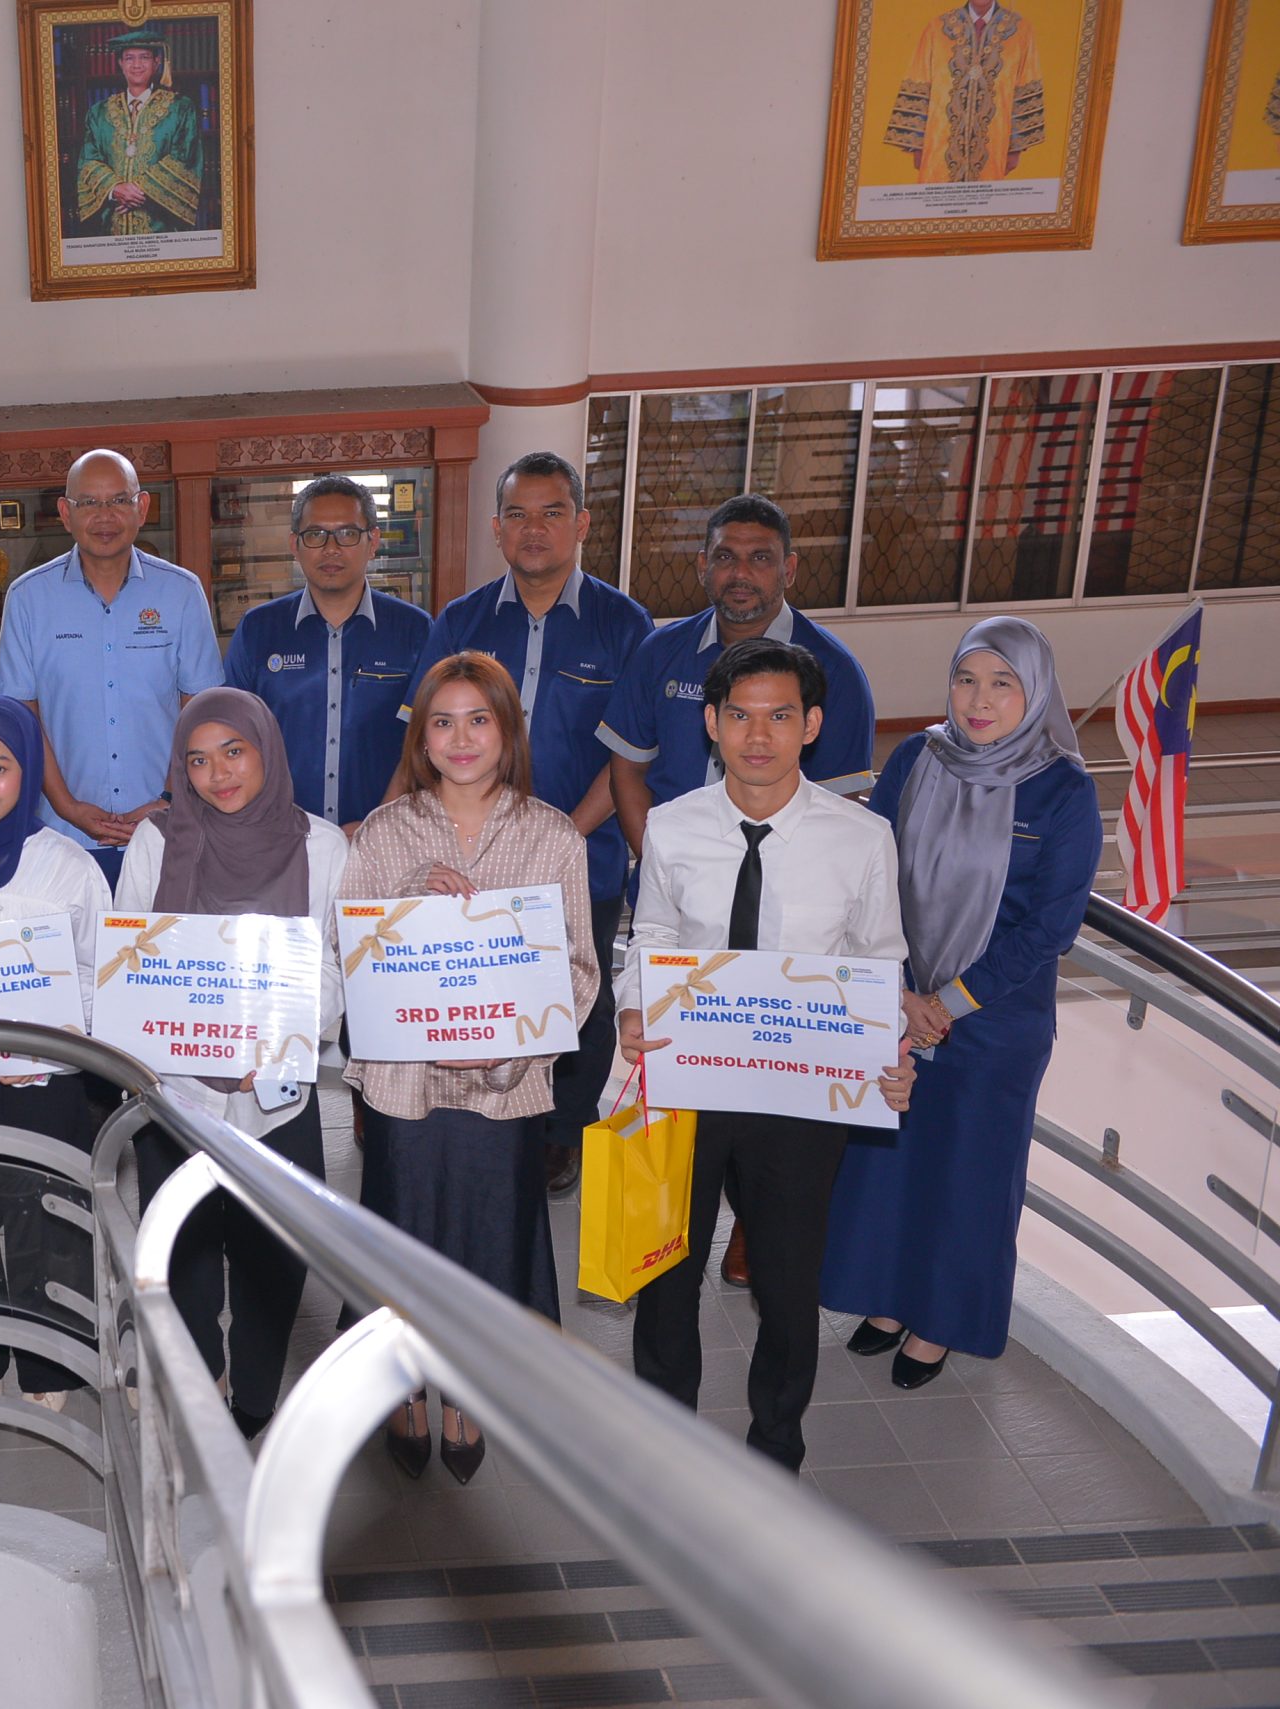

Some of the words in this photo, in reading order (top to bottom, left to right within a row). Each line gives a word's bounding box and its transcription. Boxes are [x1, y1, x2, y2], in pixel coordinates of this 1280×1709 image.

[283, 653, 305, 665] UUM
[385, 945, 417, 957] DHL
[422, 940, 474, 955] APSSC
[488, 935, 524, 949] UUM
[0, 962, 35, 977] UUM
[142, 958, 172, 970] DHL
[176, 959, 226, 972] APSSC
[372, 960, 441, 973] FINANCE
[445, 950, 541, 971] CHALLENGE
[126, 973, 193, 987] FINANCE
[439, 975, 477, 988] 2025
[188, 993, 225, 1005] 2025
[696, 995, 731, 1007] DHL
[736, 996, 792, 1010] APSSC
[807, 1002, 847, 1017] UUM
[395, 1008, 440, 1023] 3RD
[447, 1002, 517, 1022] PRIZE
[142, 1020, 185, 1037] 4TH
[193, 1023, 258, 1040] PRIZE
[680, 1011, 756, 1024] FINANCE
[760, 1014, 865, 1035] CHALLENGE
[426, 1026, 495, 1042] RM550
[752, 1030, 792, 1044] 2025
[170, 1043, 235, 1059] RM350
[676, 1054, 809, 1074] CONSOLATIONS
[815, 1065, 865, 1081] PRIZE
